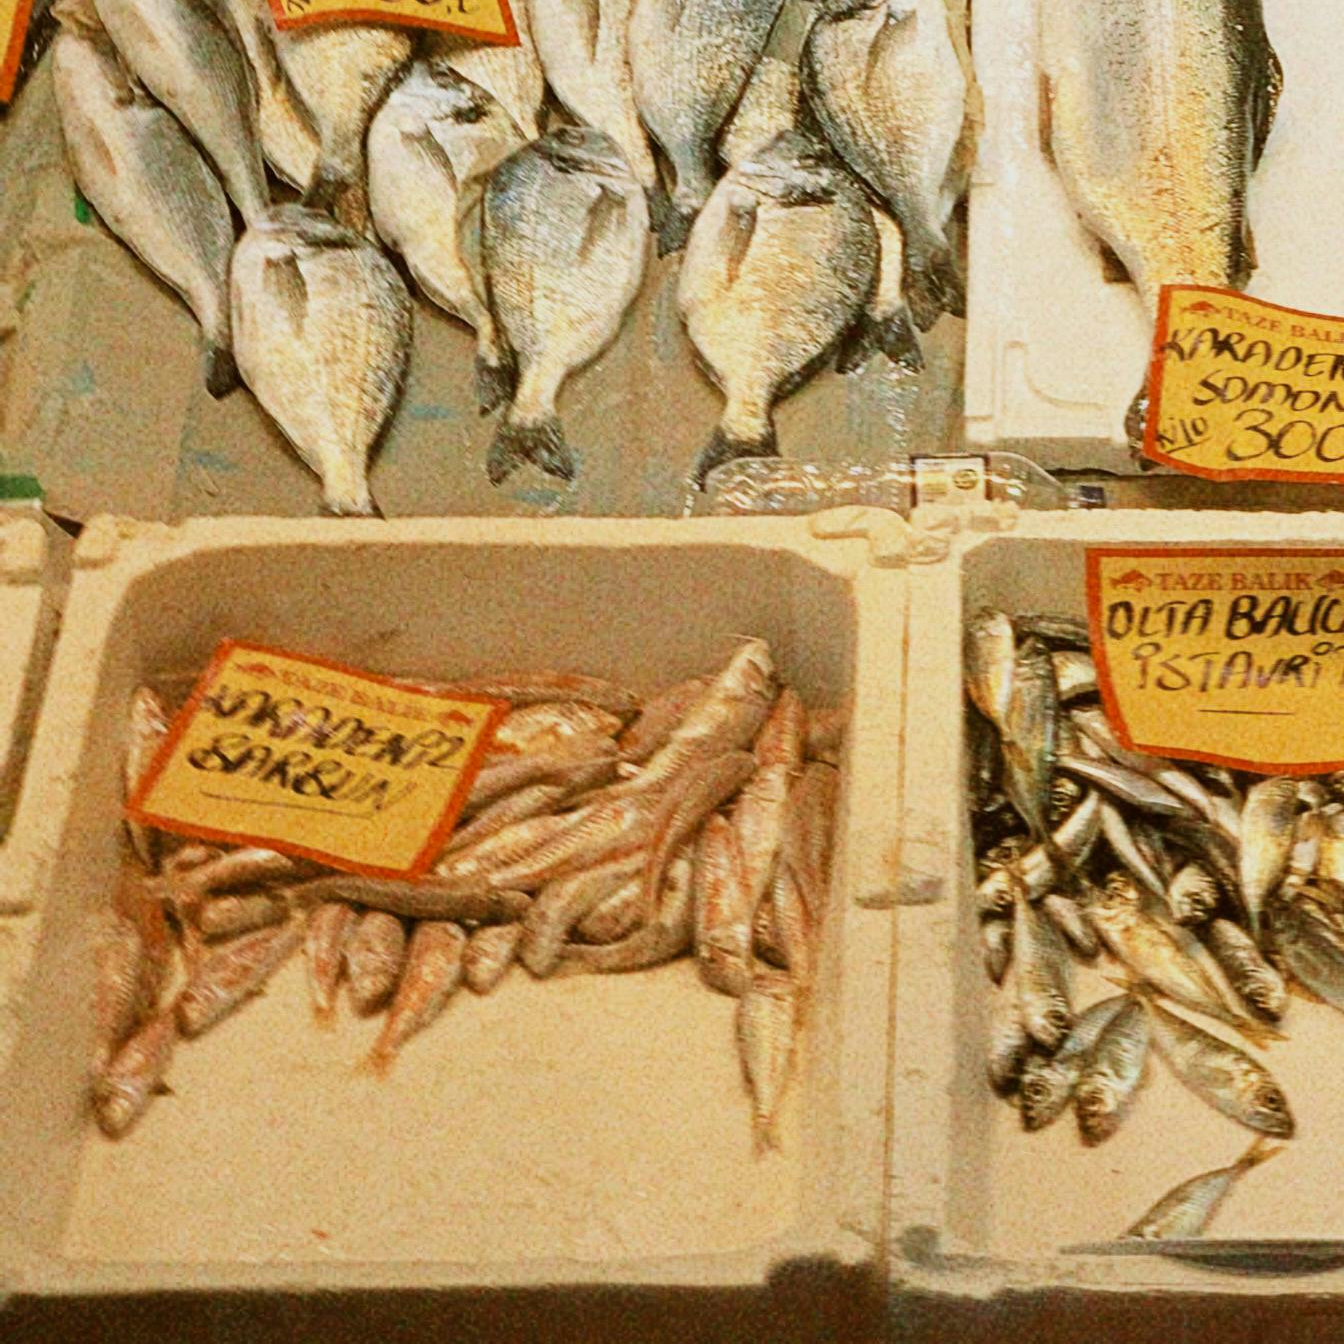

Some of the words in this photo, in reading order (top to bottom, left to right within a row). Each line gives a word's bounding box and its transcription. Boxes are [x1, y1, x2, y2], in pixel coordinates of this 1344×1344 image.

[1224, 306, 1282, 331] TAZE
[1154, 572, 1226, 591] TAZE
[1229, 572, 1316, 591] BALIK
[1106, 598, 1213, 640] OLTA
